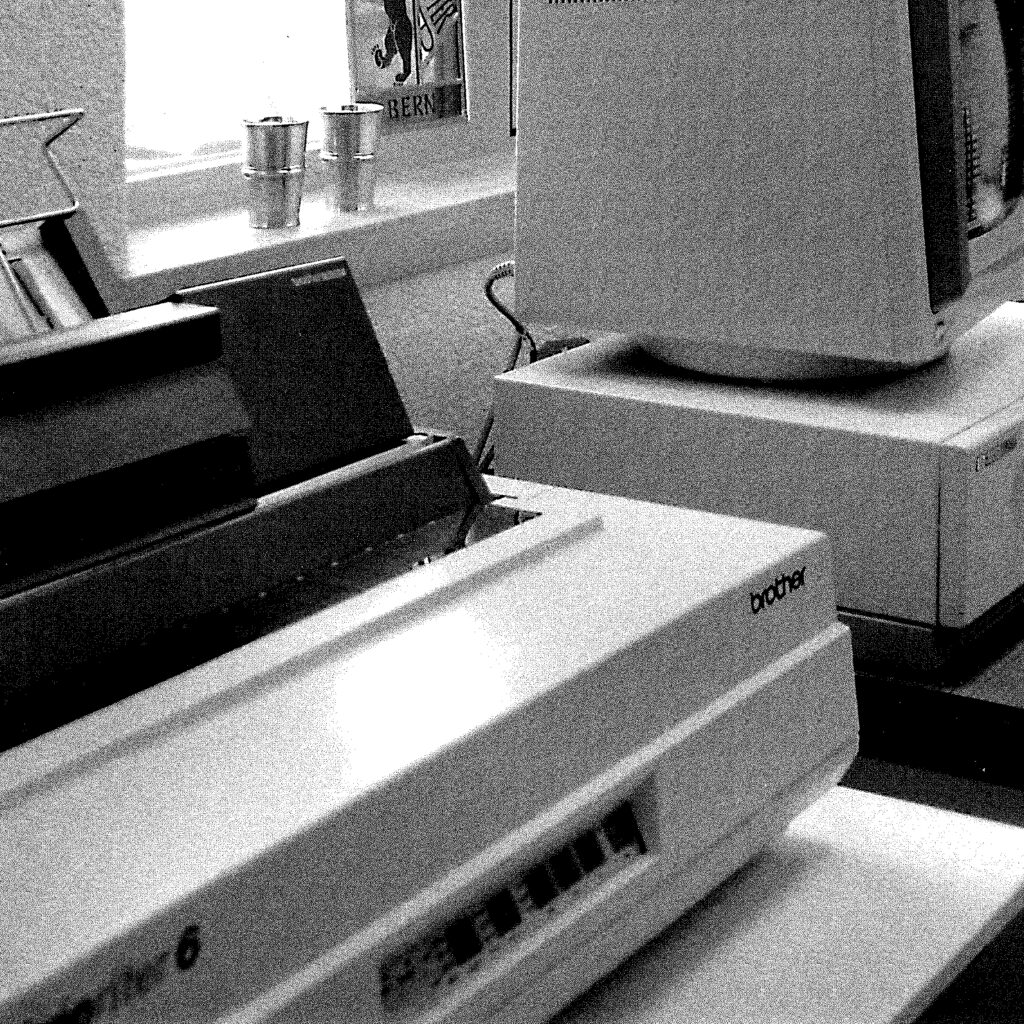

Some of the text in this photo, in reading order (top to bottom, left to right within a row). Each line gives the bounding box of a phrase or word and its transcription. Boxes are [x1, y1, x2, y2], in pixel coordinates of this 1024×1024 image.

[387, 92, 436, 120] BERN
[749, 566, 806, 614] brother
[175, 925, 200, 970] 6
